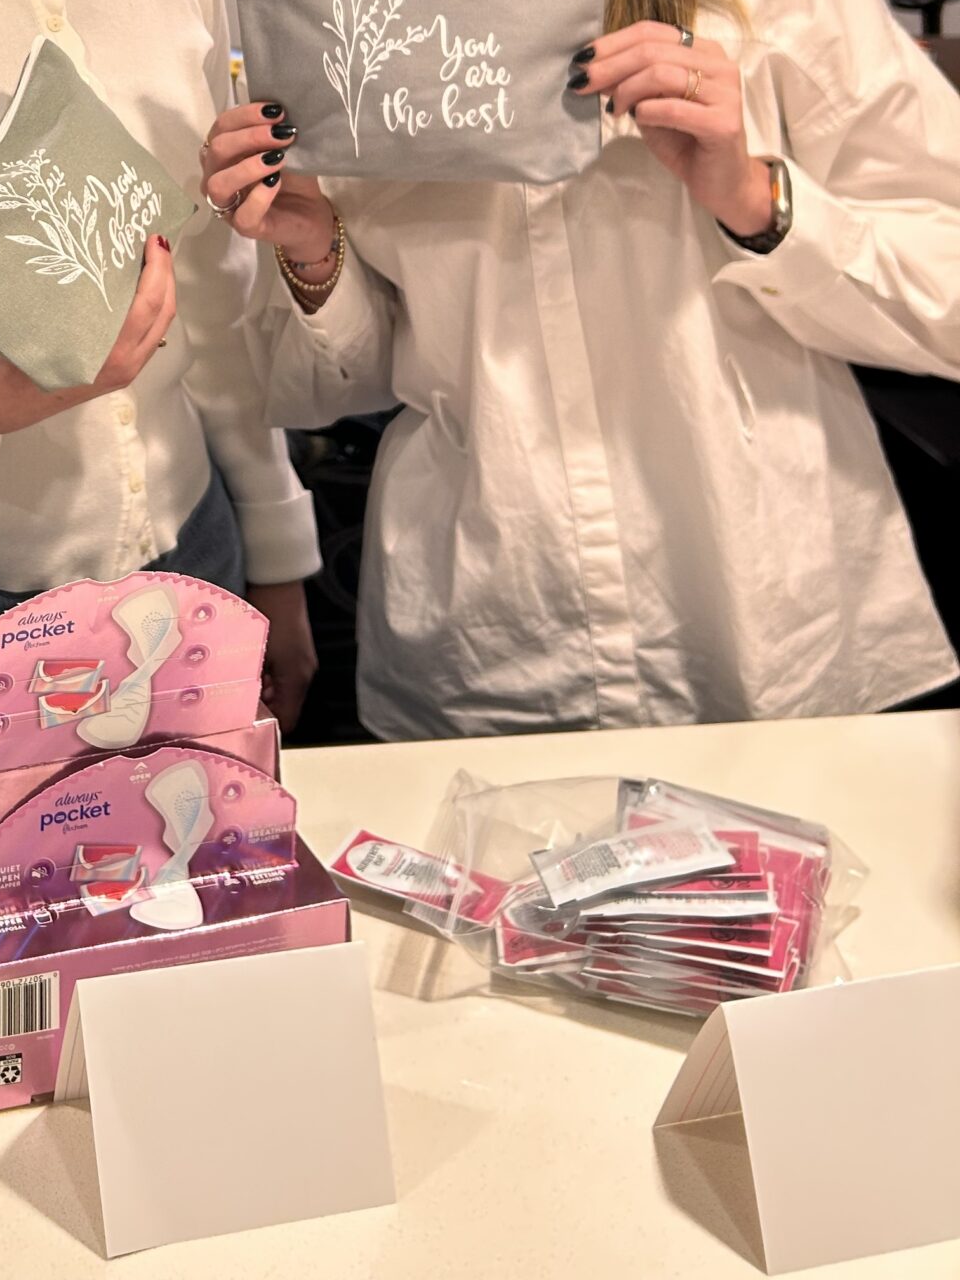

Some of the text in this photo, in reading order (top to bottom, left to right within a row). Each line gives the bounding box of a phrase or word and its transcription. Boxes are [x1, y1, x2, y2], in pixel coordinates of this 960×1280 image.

[424, 14, 501, 82] You
[464, 61, 511, 88] are
[380, 84, 515, 136] the best
[87, 161, 138, 231] You
[130, 180, 152, 211] are
[109, 193, 162, 269] chosen
[16, 608, 65, 628] always
[53, 788, 99, 809] always
[37, 801, 113, 831] pocket
[18, 975, 43, 985] 30772
